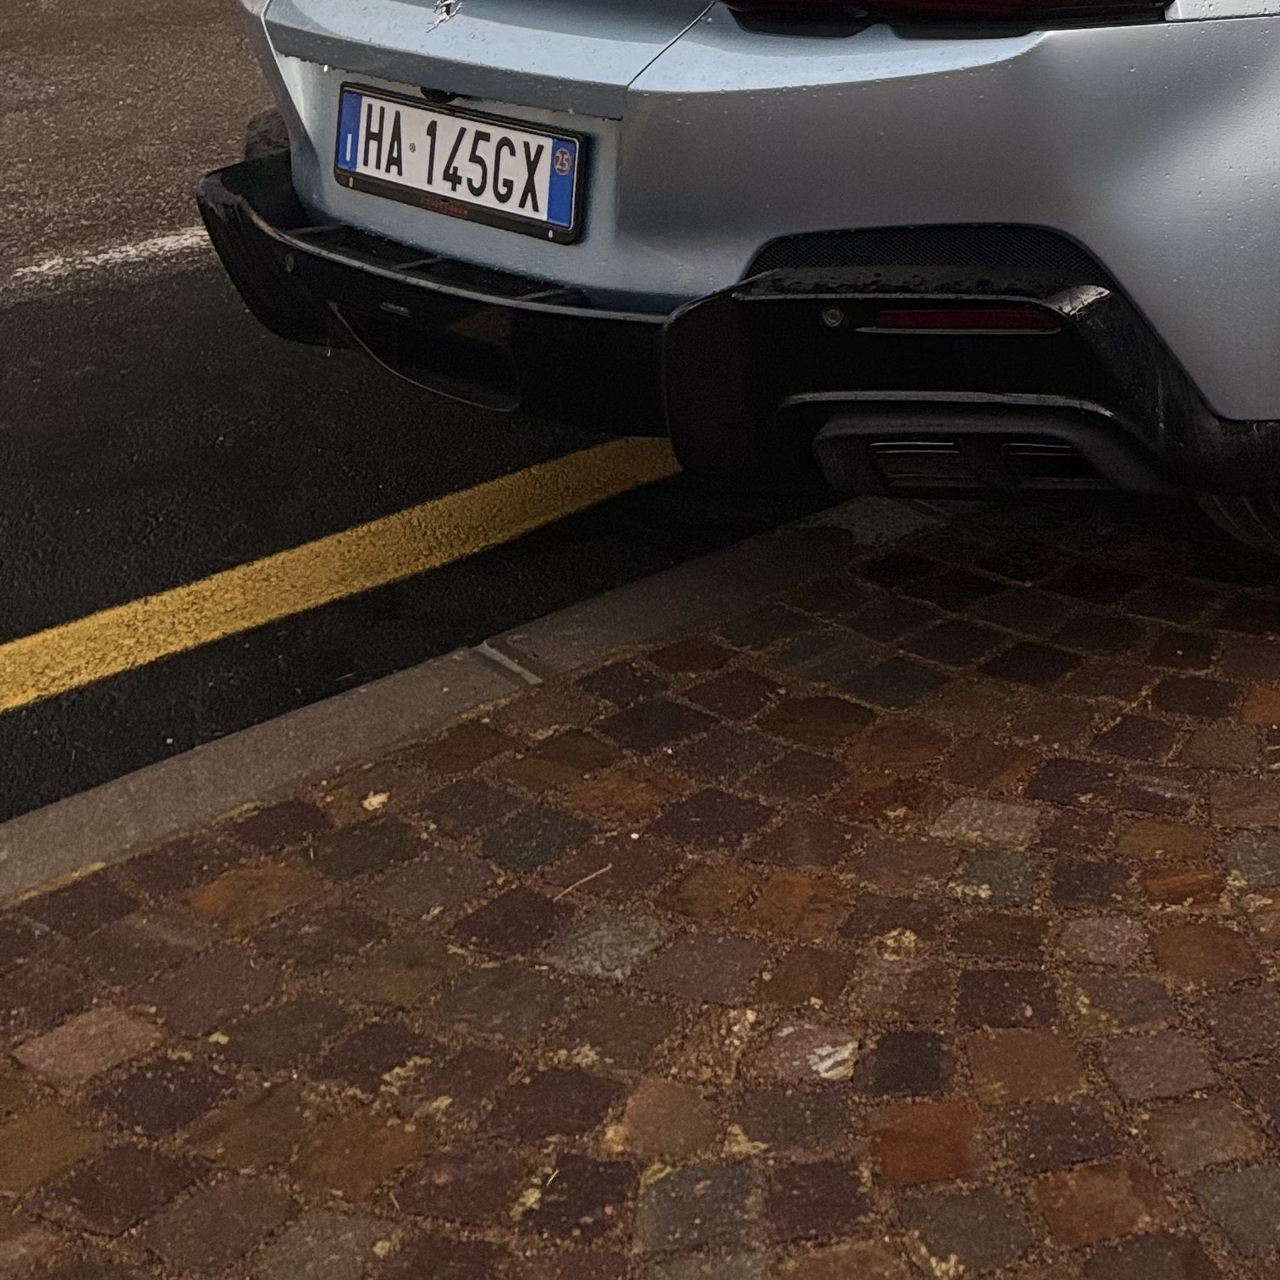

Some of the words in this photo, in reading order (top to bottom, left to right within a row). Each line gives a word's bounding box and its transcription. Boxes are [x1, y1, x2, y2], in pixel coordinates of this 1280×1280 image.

[362, 103, 403, 177] HA
[425, 120, 545, 213] 145GX
[555, 152, 570, 170] 25
